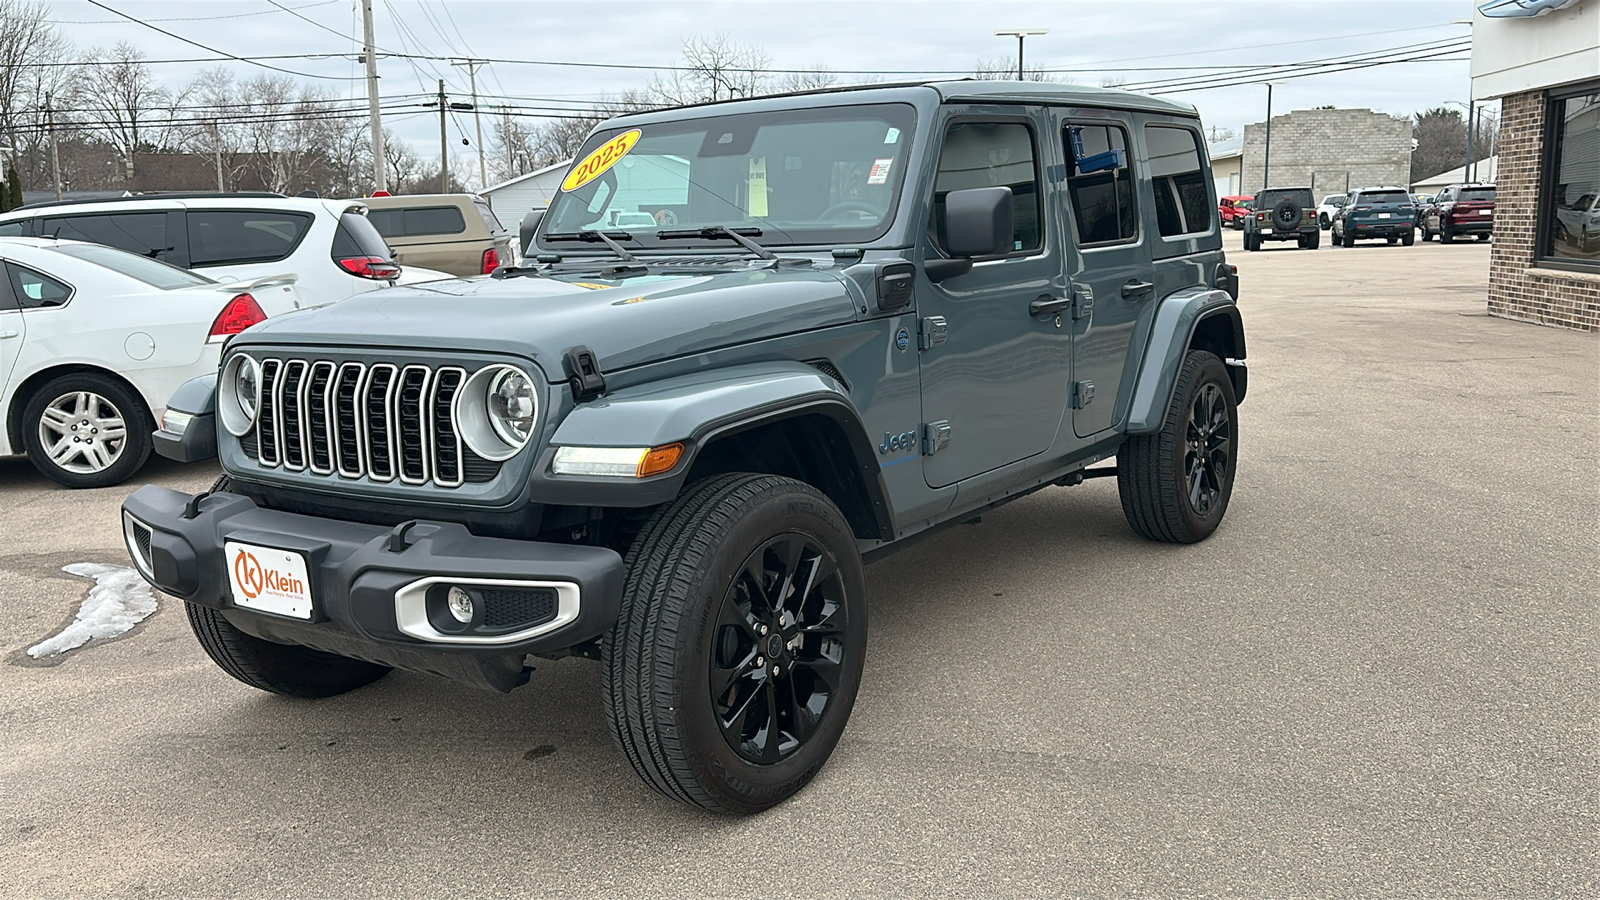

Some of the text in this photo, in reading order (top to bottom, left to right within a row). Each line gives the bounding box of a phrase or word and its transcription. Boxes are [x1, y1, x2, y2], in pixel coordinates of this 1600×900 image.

[576, 135, 627, 186] 2025
[879, 430, 917, 455] Jeep
[264, 569, 304, 595] Klein
